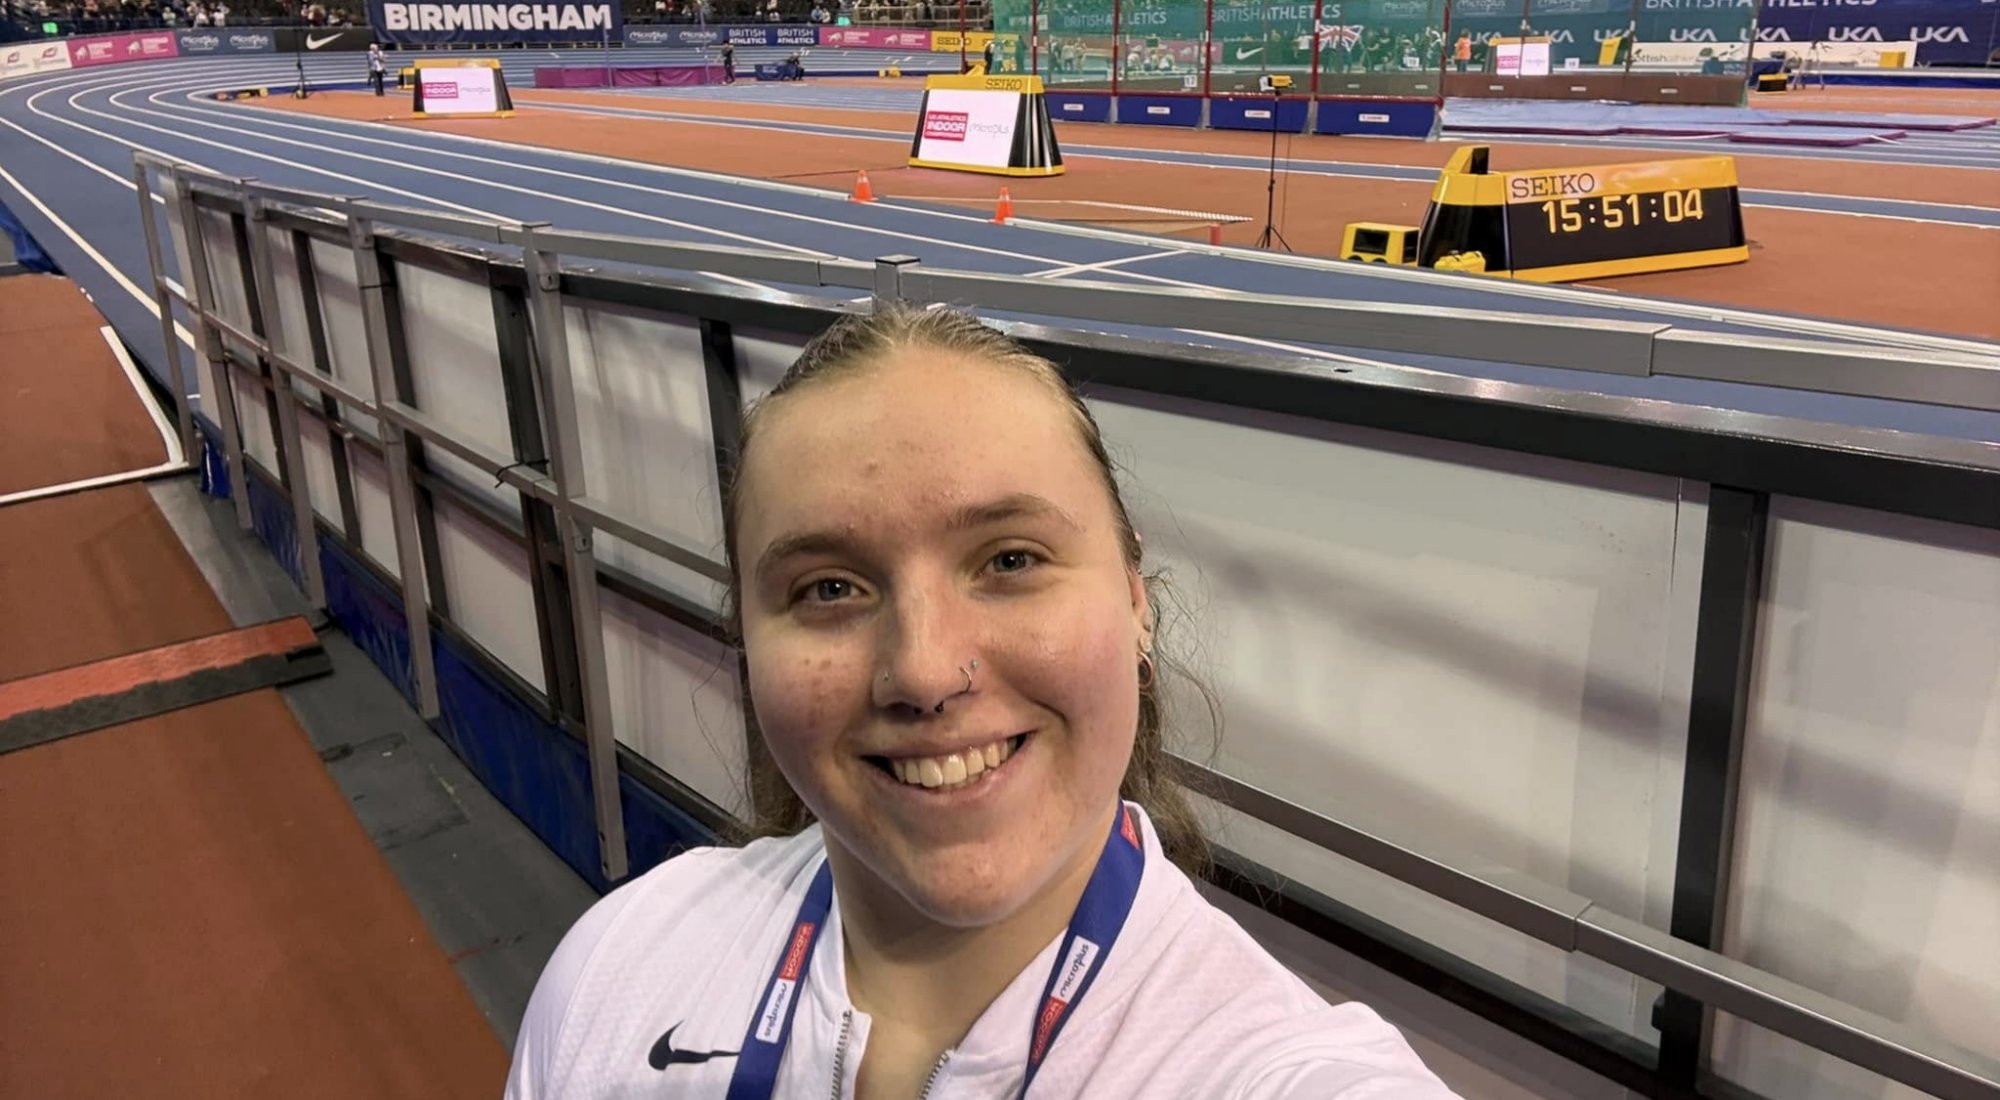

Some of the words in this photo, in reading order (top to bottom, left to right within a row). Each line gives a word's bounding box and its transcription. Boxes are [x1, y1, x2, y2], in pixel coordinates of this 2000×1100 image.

[384, 3, 613, 31] BIRMINGHAM
[1105, 11, 1167, 26] ALETICS
[1261, 4, 1341, 20] ATHLETCS
[729, 28, 766, 37] BRITISH
[777, 28, 814, 37] BRITISH
[1670, 28, 1717, 41] UKA
[1828, 26, 1883, 41] UKA
[1910, 26, 1970, 42] UKA
[985, 79, 1022, 90] SEIKO
[927, 121, 965, 132] INDOOR
[1511, 173, 1595, 198] SEIKO
[1542, 188, 1703, 233] 15:51:04
[1060, 943, 1089, 997] microplus
